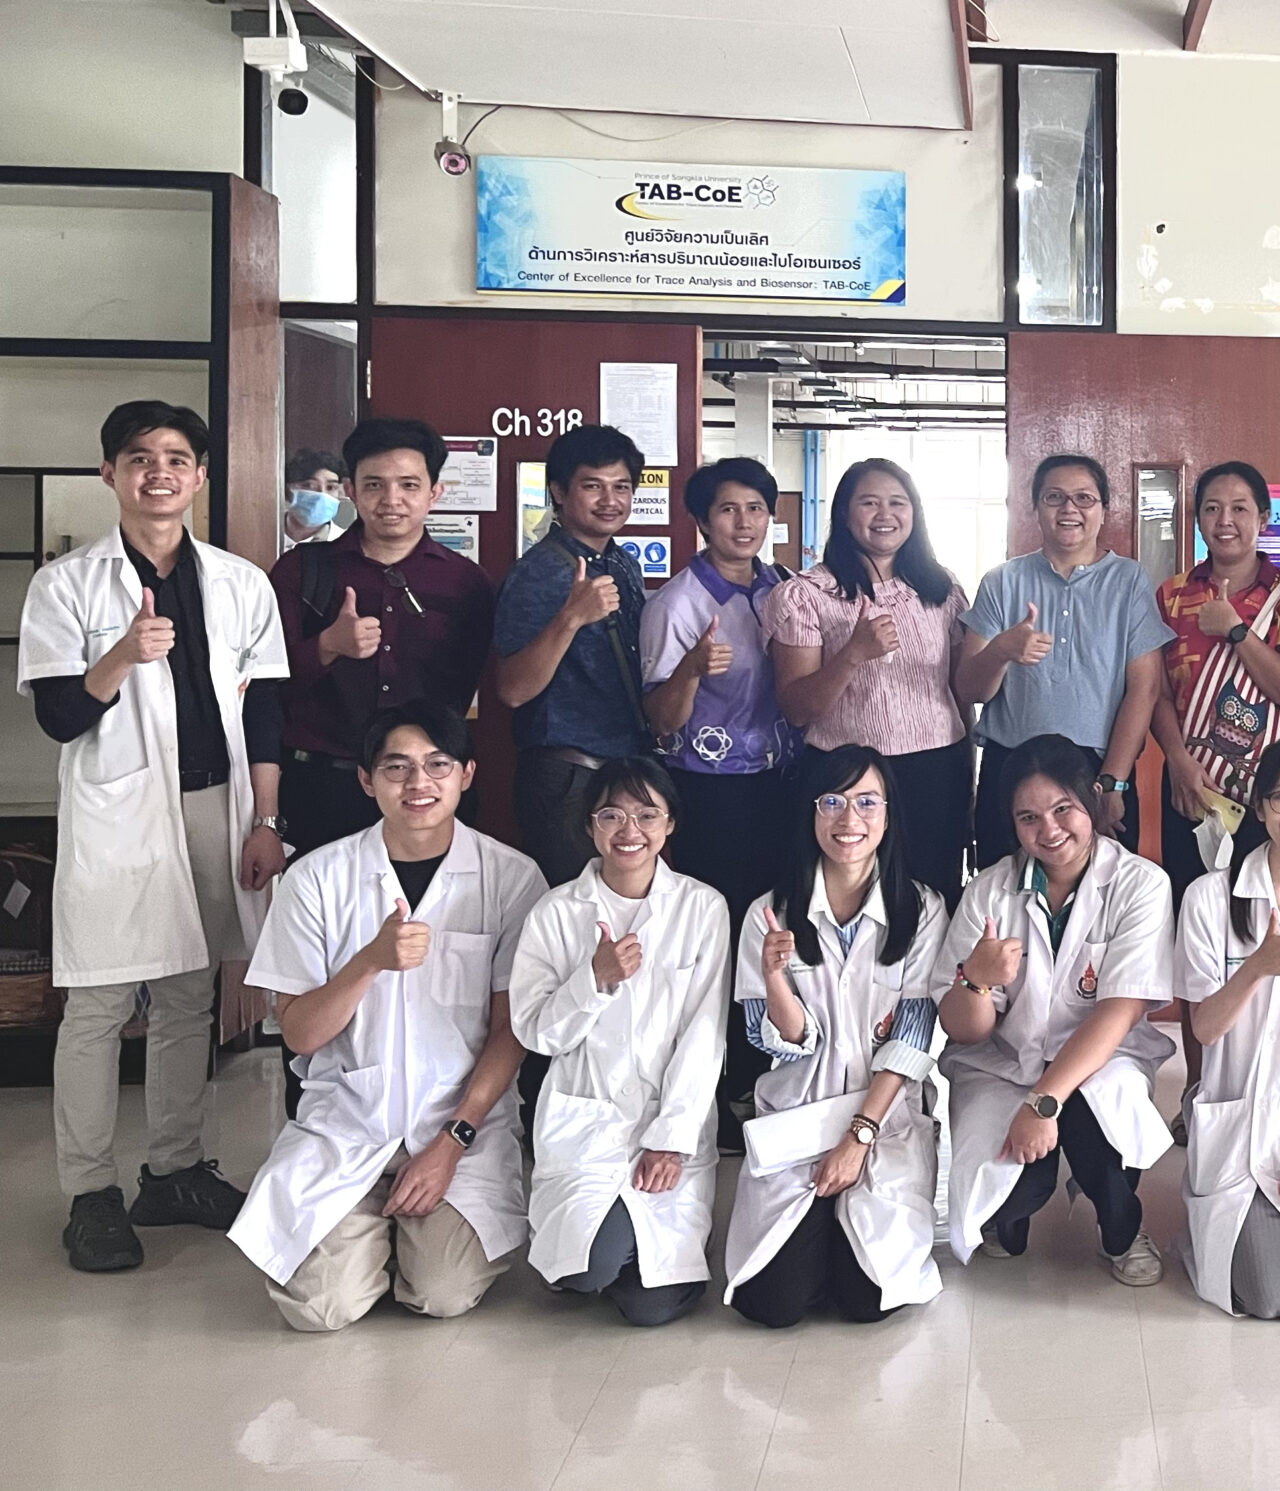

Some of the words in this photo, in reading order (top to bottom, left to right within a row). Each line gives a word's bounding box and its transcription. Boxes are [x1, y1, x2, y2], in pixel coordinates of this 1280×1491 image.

[635, 182, 742, 203] TAB-CoE
[624, 228, 769, 247] ศูนย์วิจัยความเป็นเลิศ
[528, 247, 861, 271] ด้านการวิเคราะห์สารปริมาณน้อยและไบโอเซนเซอร์
[517, 270, 554, 281] Center
[559, 272, 570, 281] of
[574, 272, 632, 283] Excellence
[636, 274, 650, 284] for
[655, 275, 685, 285] Trace
[688, 276, 733, 288] Analysis
[737, 278, 756, 287] and
[761, 278, 818, 289] Biosensor:
[823, 280, 871, 291] TAB-CoE
[492, 407, 531, 437] Ch
[537, 408, 583, 437] 318
[632, 497, 667, 505] ZARDOUS
